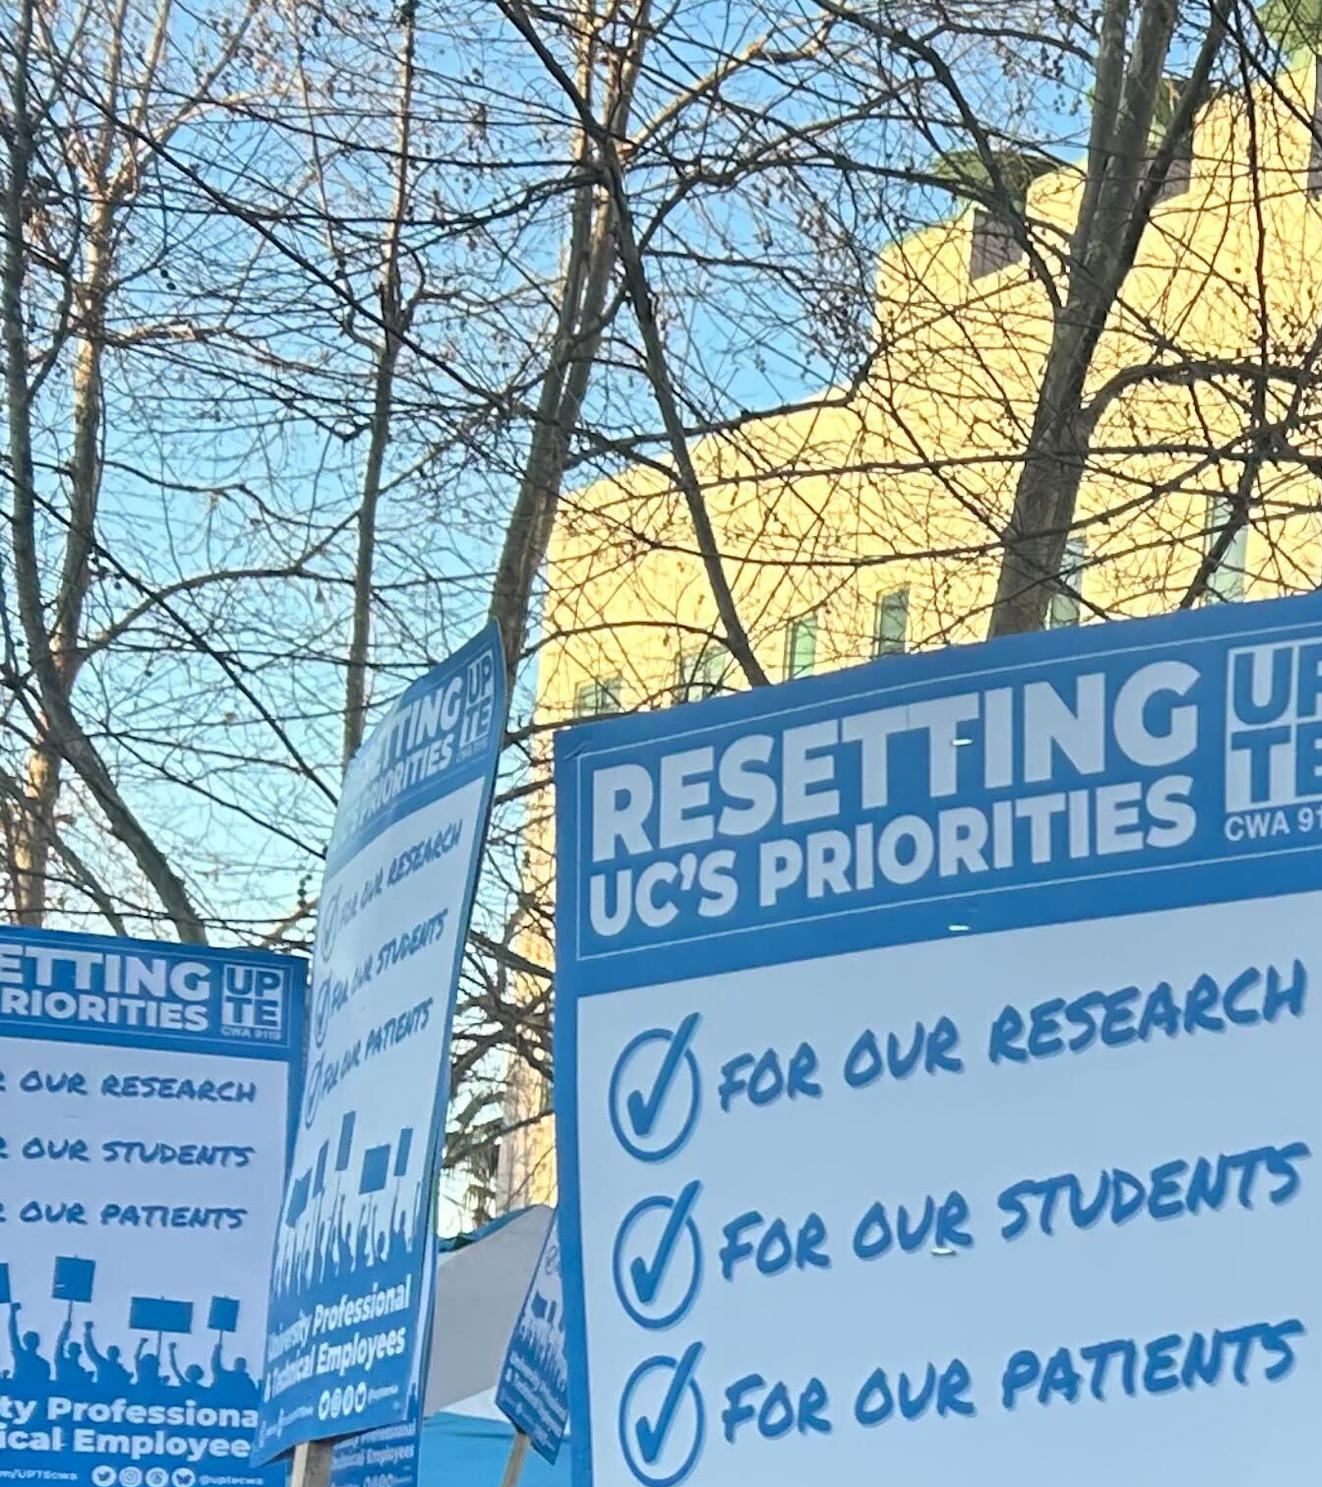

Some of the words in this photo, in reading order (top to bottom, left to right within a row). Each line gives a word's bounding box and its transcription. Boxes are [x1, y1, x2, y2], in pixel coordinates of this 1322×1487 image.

[590, 660, 1201, 862] RESETTING
[387, 819, 463, 885] RESEARCH
[1223, 809, 1291, 843] CWA
[589, 860, 738, 936] UC'S
[759, 776, 1197, 908] PRIORITIES
[376, 909, 448, 975] STUDENTS
[0, 943, 211, 1000] ETTING
[226, 967, 281, 997] UP
[2, 987, 209, 1032] RIORITIES
[225, 996, 279, 1027] TE
[365, 997, 433, 1060] PATIENTS
[717, 1049, 823, 1112] FOR
[844, 1017, 964, 1084] OUR
[988, 959, 1308, 1064] RESEARCH
[20, 1070, 88, 1095] OUR
[101, 1074, 256, 1103] RESEARCH
[22, 1137, 90, 1162] OUR
[103, 1141, 255, 1168] STUDENTS
[20, 1201, 88, 1225] OUR
[101, 1204, 248, 1230] PATIENTS
[719, 1211, 830, 1282] FOR
[853, 1190, 973, 1258] OUR
[998, 1143, 1312, 1242] STUDENTS
[312, 1274, 411, 1336] Professional
[316, 1326, 406, 1376] Employees
[721, 1371, 832, 1442] FOR
[854, 1359, 976, 1425] OUR
[1000, 1319, 1307, 1407] PATIENTS
[47, 1396, 258, 1429] Professiona
[73, 1428, 250, 1460] Employee
